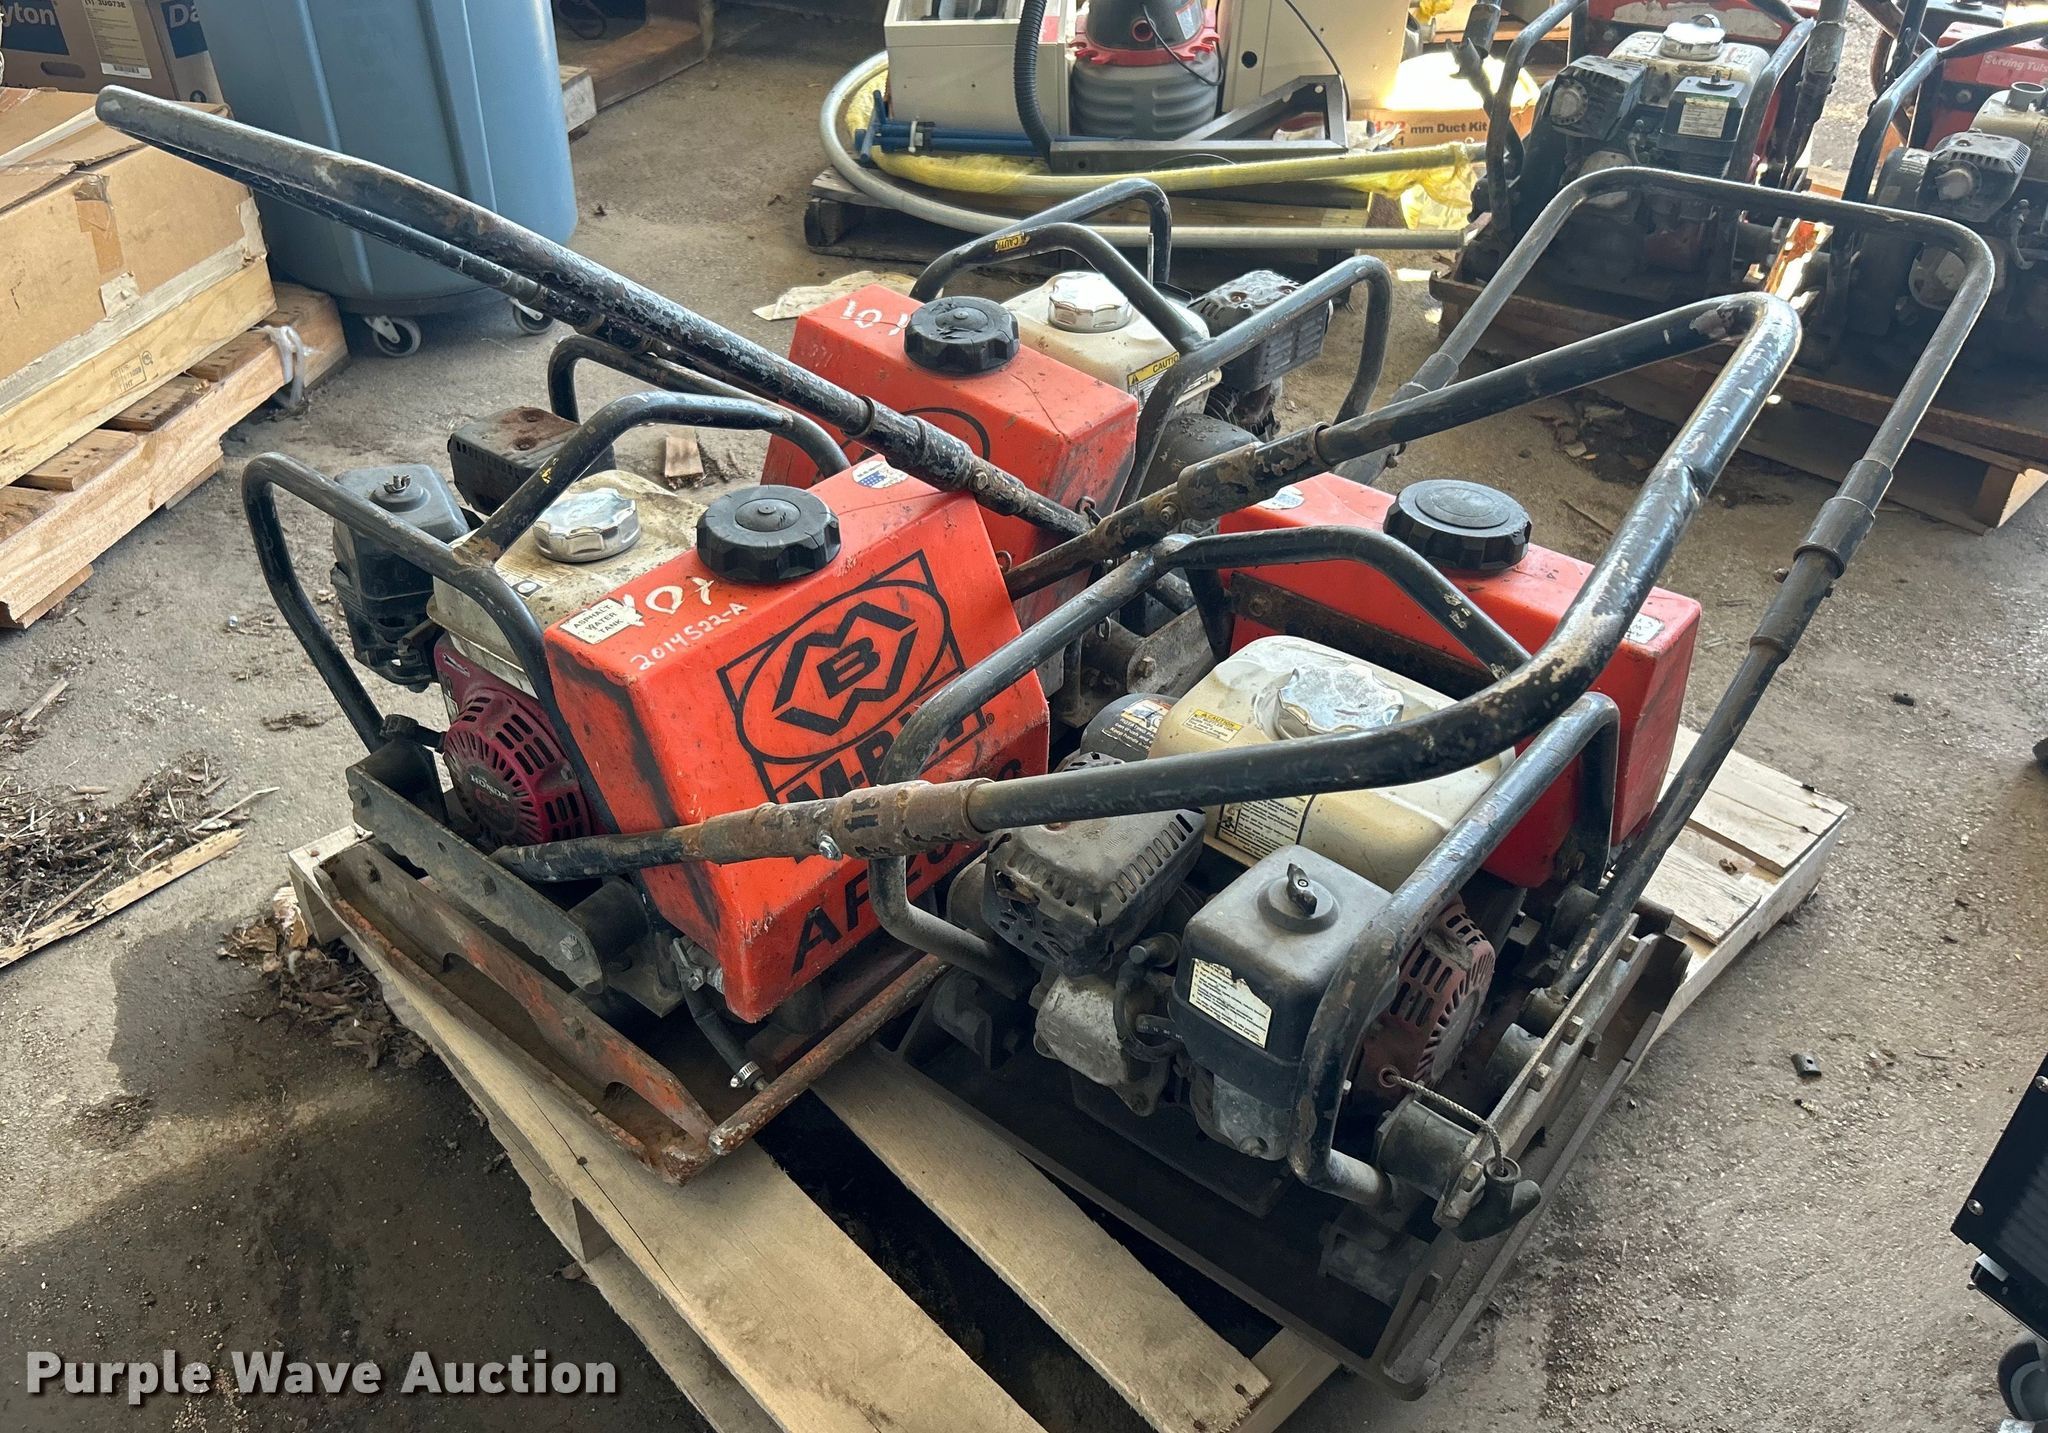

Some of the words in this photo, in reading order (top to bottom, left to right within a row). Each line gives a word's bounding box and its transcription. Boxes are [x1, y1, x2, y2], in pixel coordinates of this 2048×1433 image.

[1984, 54, 2025, 71] Serving
[1410, 125, 1434, 134] mm
[1436, 122, 1466, 133] Duct
[1468, 121, 1487, 132] Kit
[1152, 354, 1180, 373] CAUTIO
[573, 604, 612, 629] ASPHALT
[585, 612, 618, 632] WATER
[599, 619, 625, 634] TANK
[629, 602, 748, 671] 2014522-A
